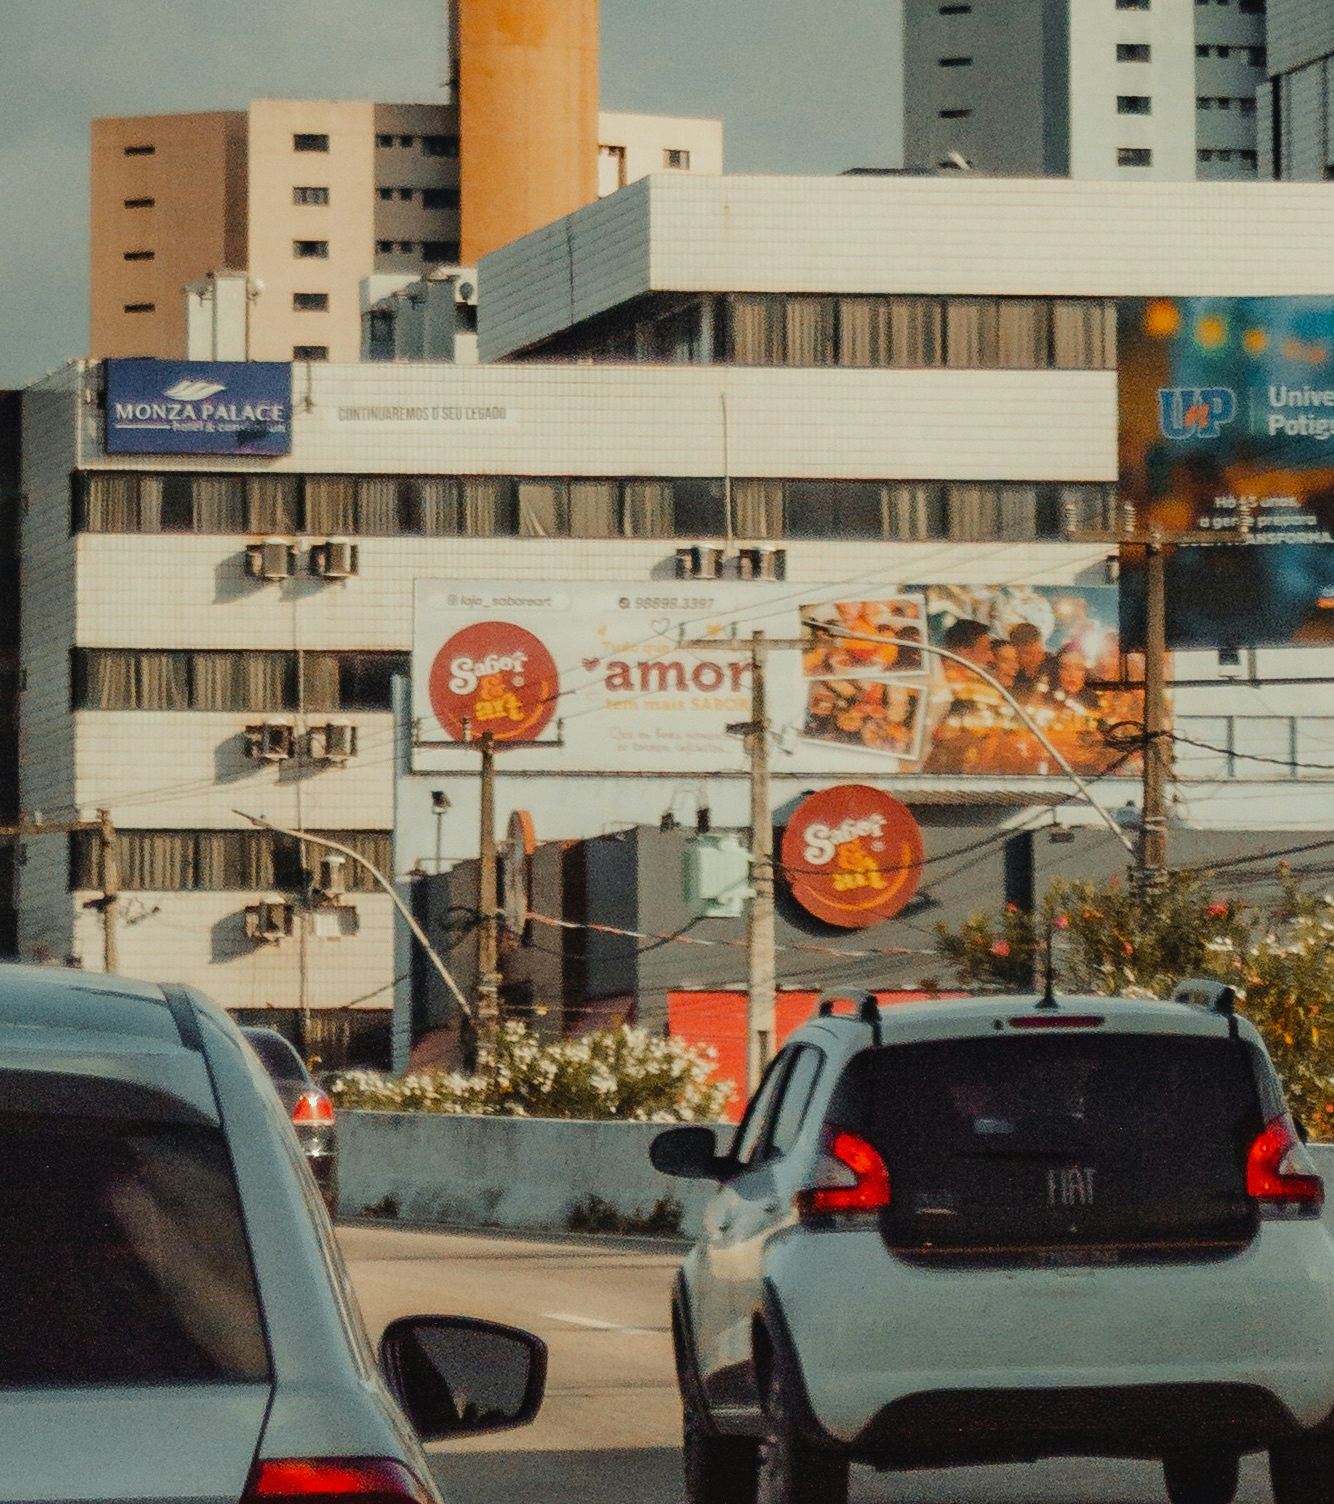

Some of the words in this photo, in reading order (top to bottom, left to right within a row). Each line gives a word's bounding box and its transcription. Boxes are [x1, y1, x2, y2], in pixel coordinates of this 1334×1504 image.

[115, 404, 197, 420] MONZA
[201, 404, 285, 422] PALACE
[604, 660, 756, 693] amor
[474, 691, 525, 721] art
